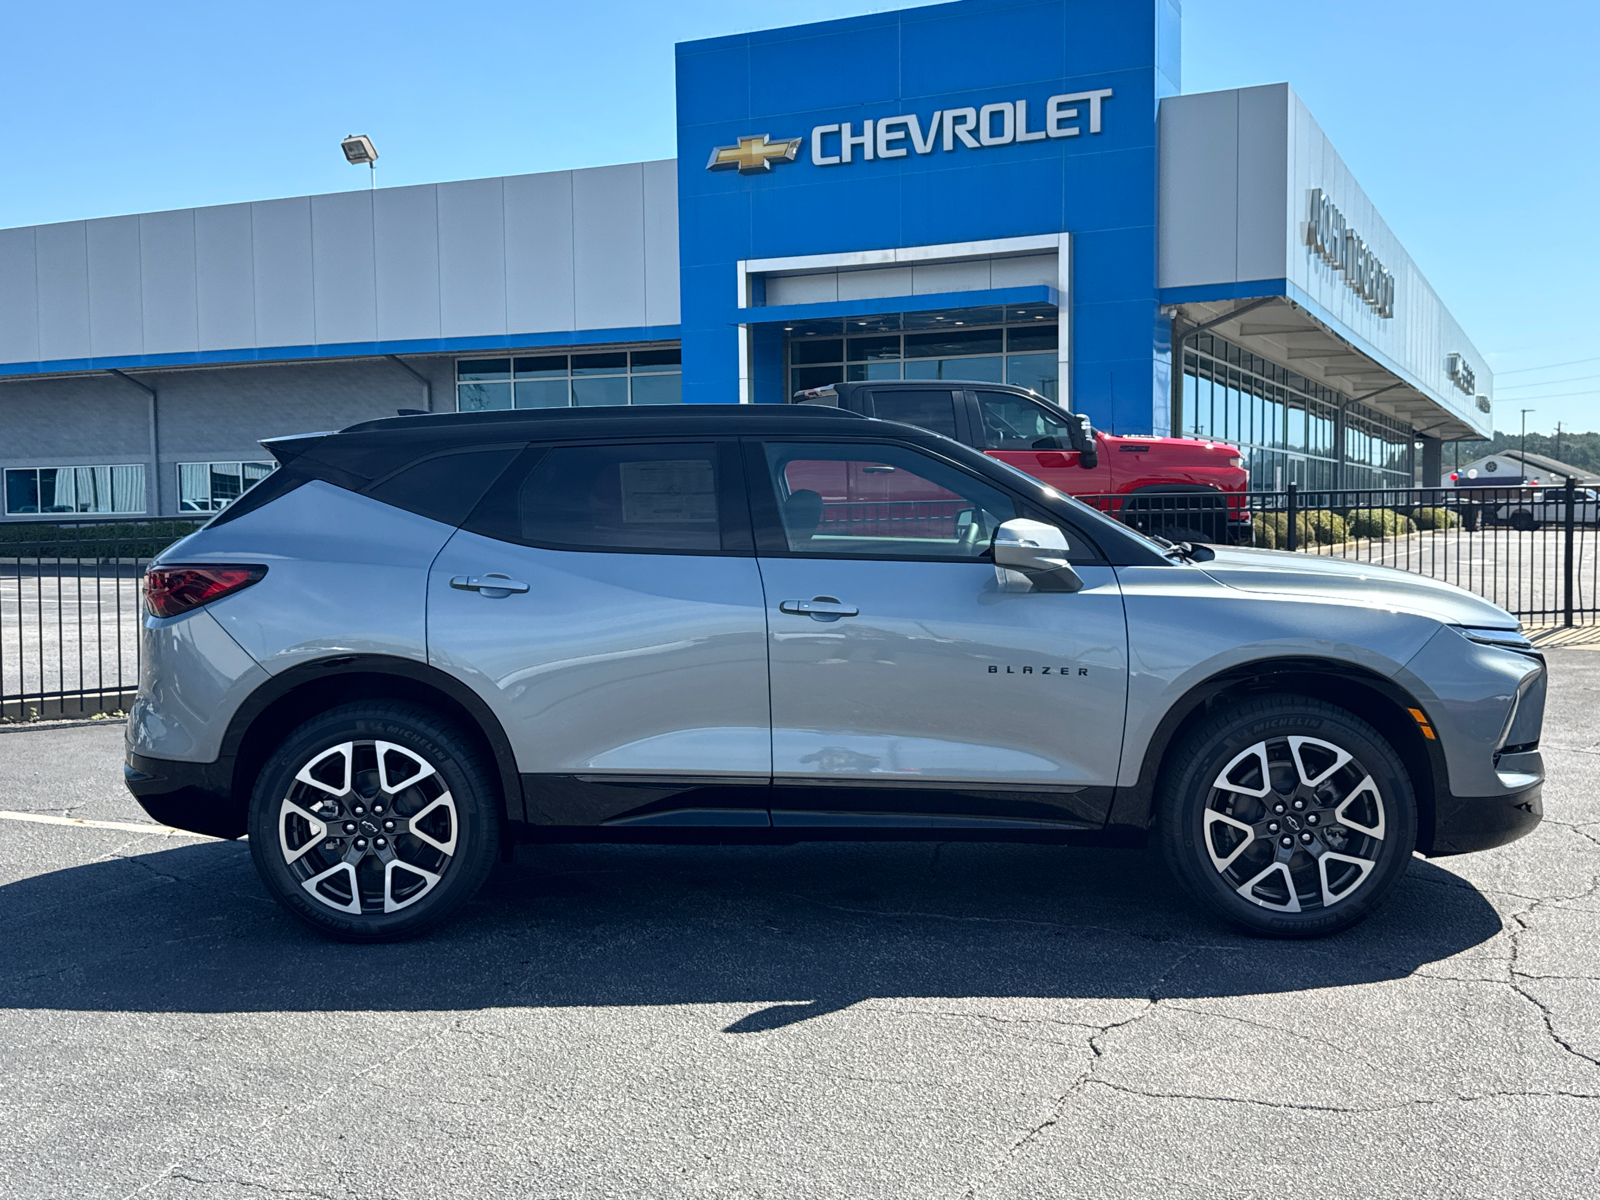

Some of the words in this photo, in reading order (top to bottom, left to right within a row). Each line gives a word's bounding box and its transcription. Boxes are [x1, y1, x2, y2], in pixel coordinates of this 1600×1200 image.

[811, 88, 1113, 166] CHEVROLET
[988, 665, 1088, 676] BLAZER
[386, 725, 447, 761] MICHELIN
[1253, 717, 1321, 733] MICHELIN
[1329, 723, 1364, 744] PRIMACY
[290, 895, 351, 930] MICHELIN
[1271, 915, 1338, 930] MICHELIN
